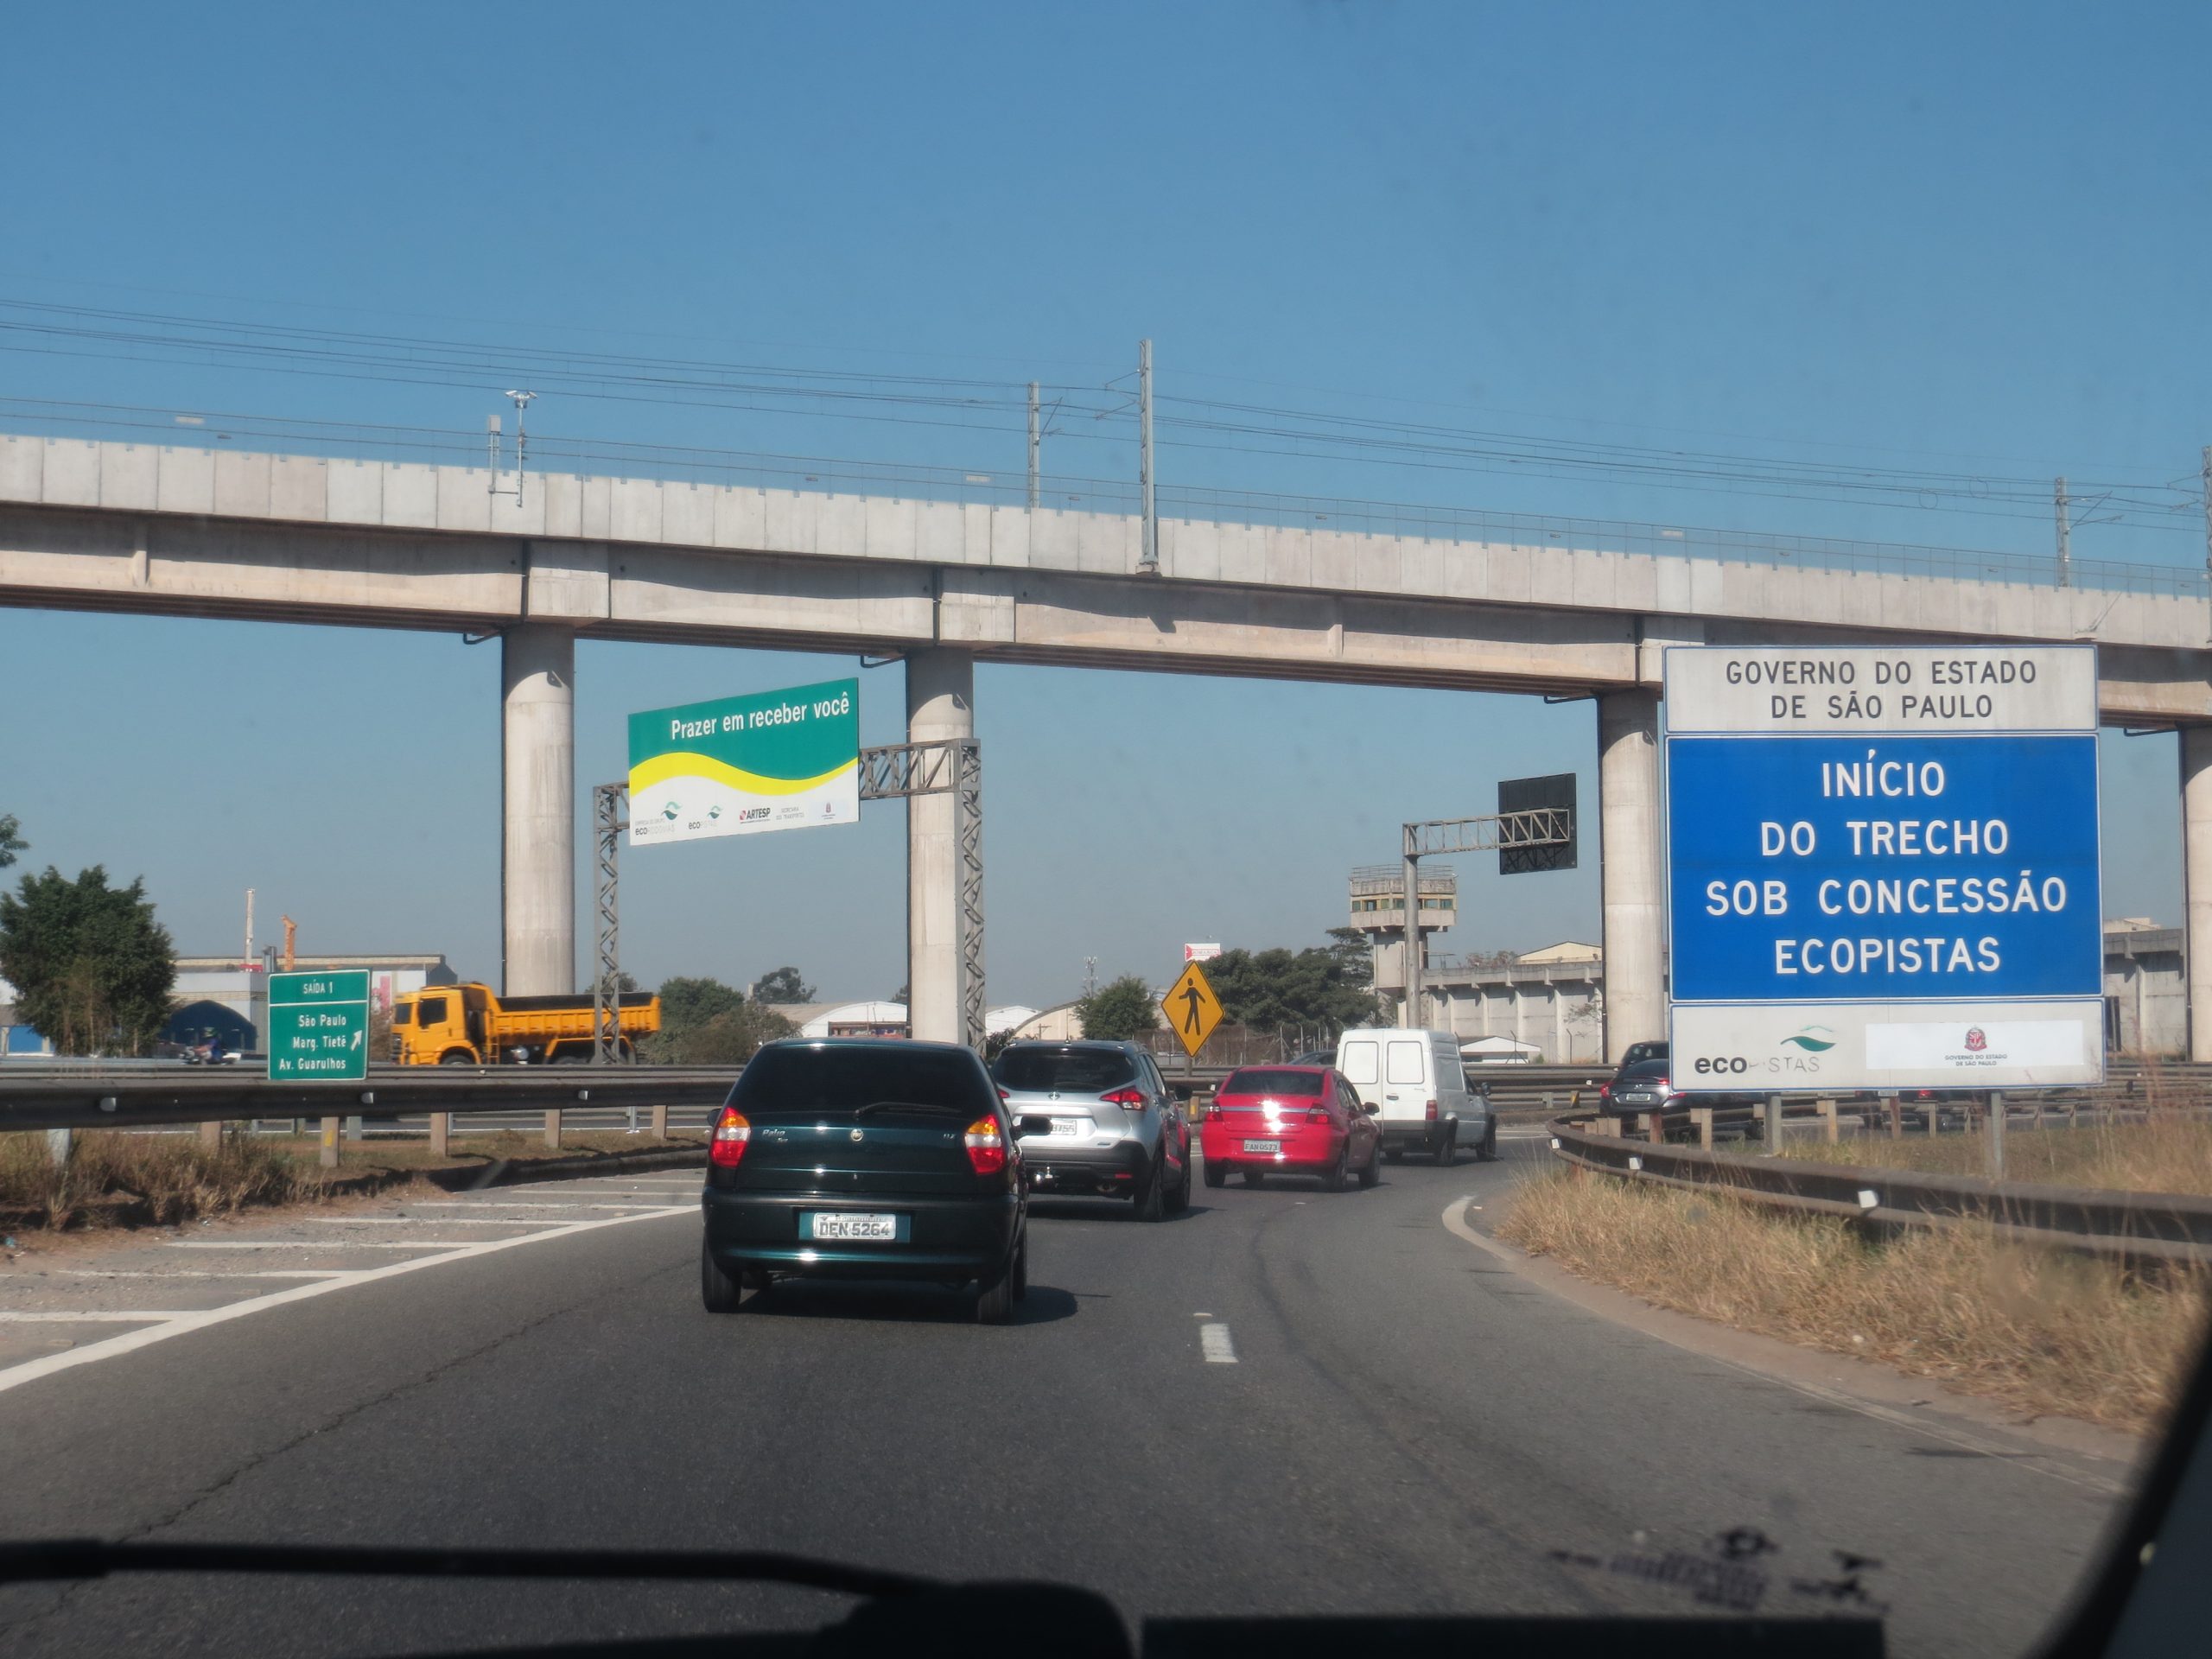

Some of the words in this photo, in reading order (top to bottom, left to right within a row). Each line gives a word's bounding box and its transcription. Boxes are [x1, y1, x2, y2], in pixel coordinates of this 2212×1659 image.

[1726, 660, 1856, 685] GOVERNO
[1875, 660, 1912, 684] DO
[1931, 659, 2037, 683] ESTADO
[671, 718, 717, 741] Prazer
[722, 712, 744, 732] em
[749, 702, 807, 730] receber
[813, 691, 849, 719] você
[1770, 696, 1806, 718] DE
[1827, 690, 1882, 719] SÃO
[1901, 694, 1993, 718] PAULO
[1822, 749, 1946, 797] INÍCIO
[747, 807, 771, 820] ARTESP
[1761, 821, 1816, 856] DO
[1847, 819, 2009, 855] TRECHO
[1706, 880, 1788, 916] SOB
[1818, 869, 2067, 915] CONCESSÃO
[1776, 936, 2001, 975] ECOPISTAS
[303, 979, 326, 995] SAÍDA
[329, 982, 334, 994] 1
[298, 1014, 316, 1027] São
[320, 1014, 346, 1027] Paulo
[293, 1036, 318, 1052] Marg.
[279, 1058, 294, 1071] Av.
[298, 1057, 346, 1070] Guarulhos
